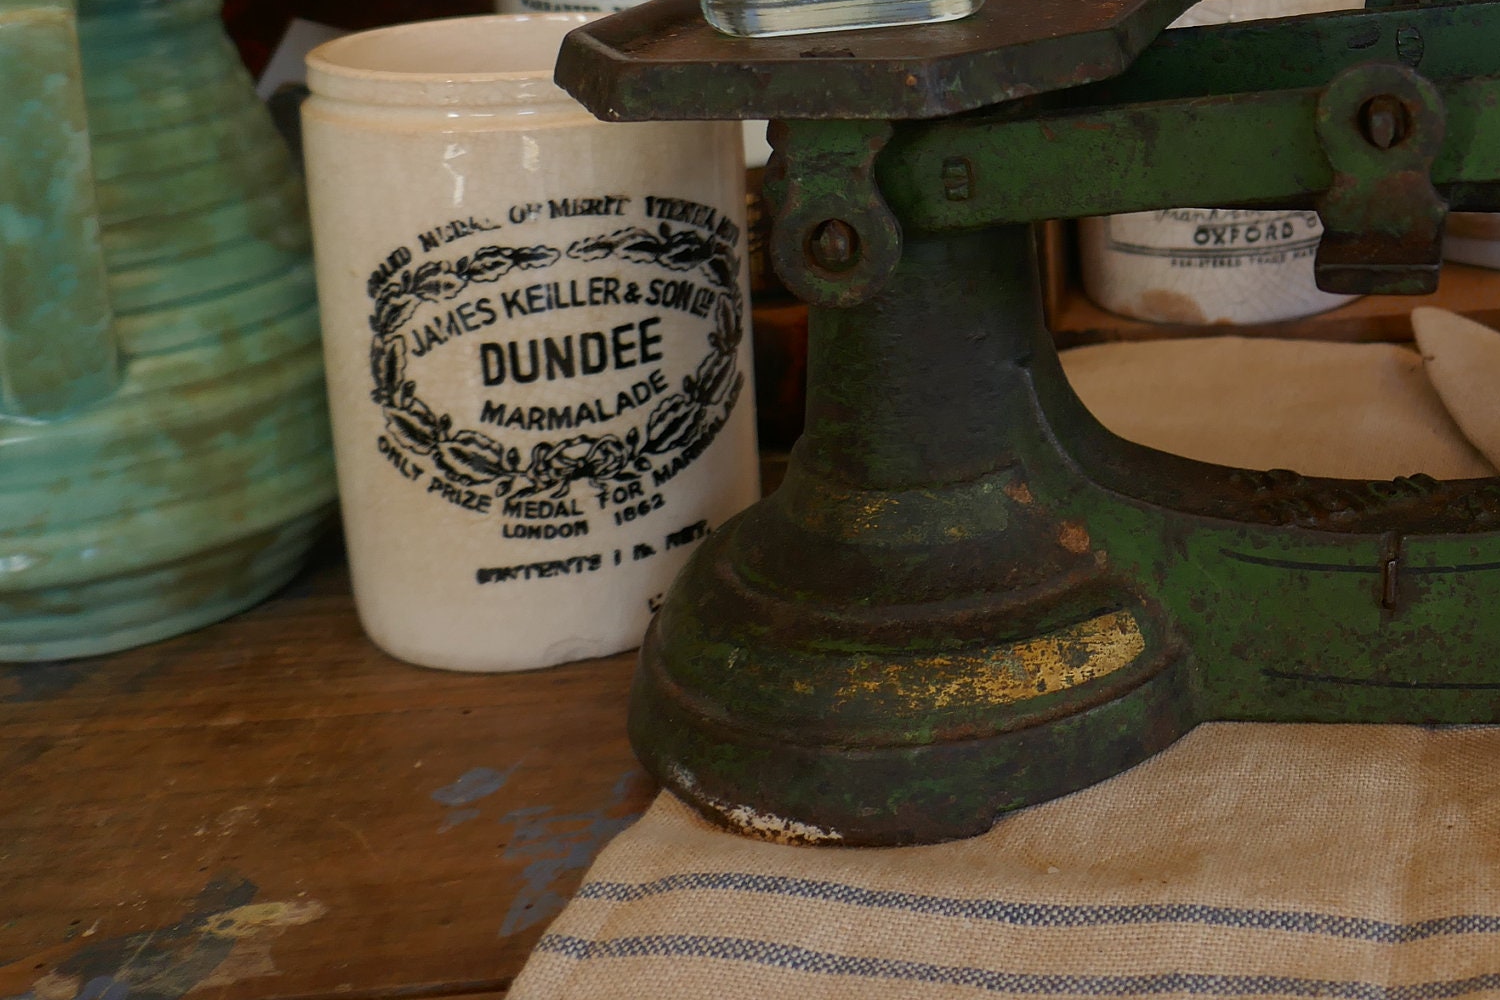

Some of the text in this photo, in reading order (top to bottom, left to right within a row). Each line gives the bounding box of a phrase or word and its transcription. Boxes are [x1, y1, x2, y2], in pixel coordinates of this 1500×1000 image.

[1193, 221, 1294, 245] OXFORD
[411, 297, 496, 357] JAMES
[501, 277, 621, 318] KEILLER
[624, 281, 642, 304] &
[645, 278, 695, 312] SON
[479, 316, 665, 387] DUNDEE
[480, 367, 669, 432] MARMALADE
[377, 436, 645, 520] ONLY PRIZE MEDAL FOR
[502, 493, 666, 540] LONDON 1862
